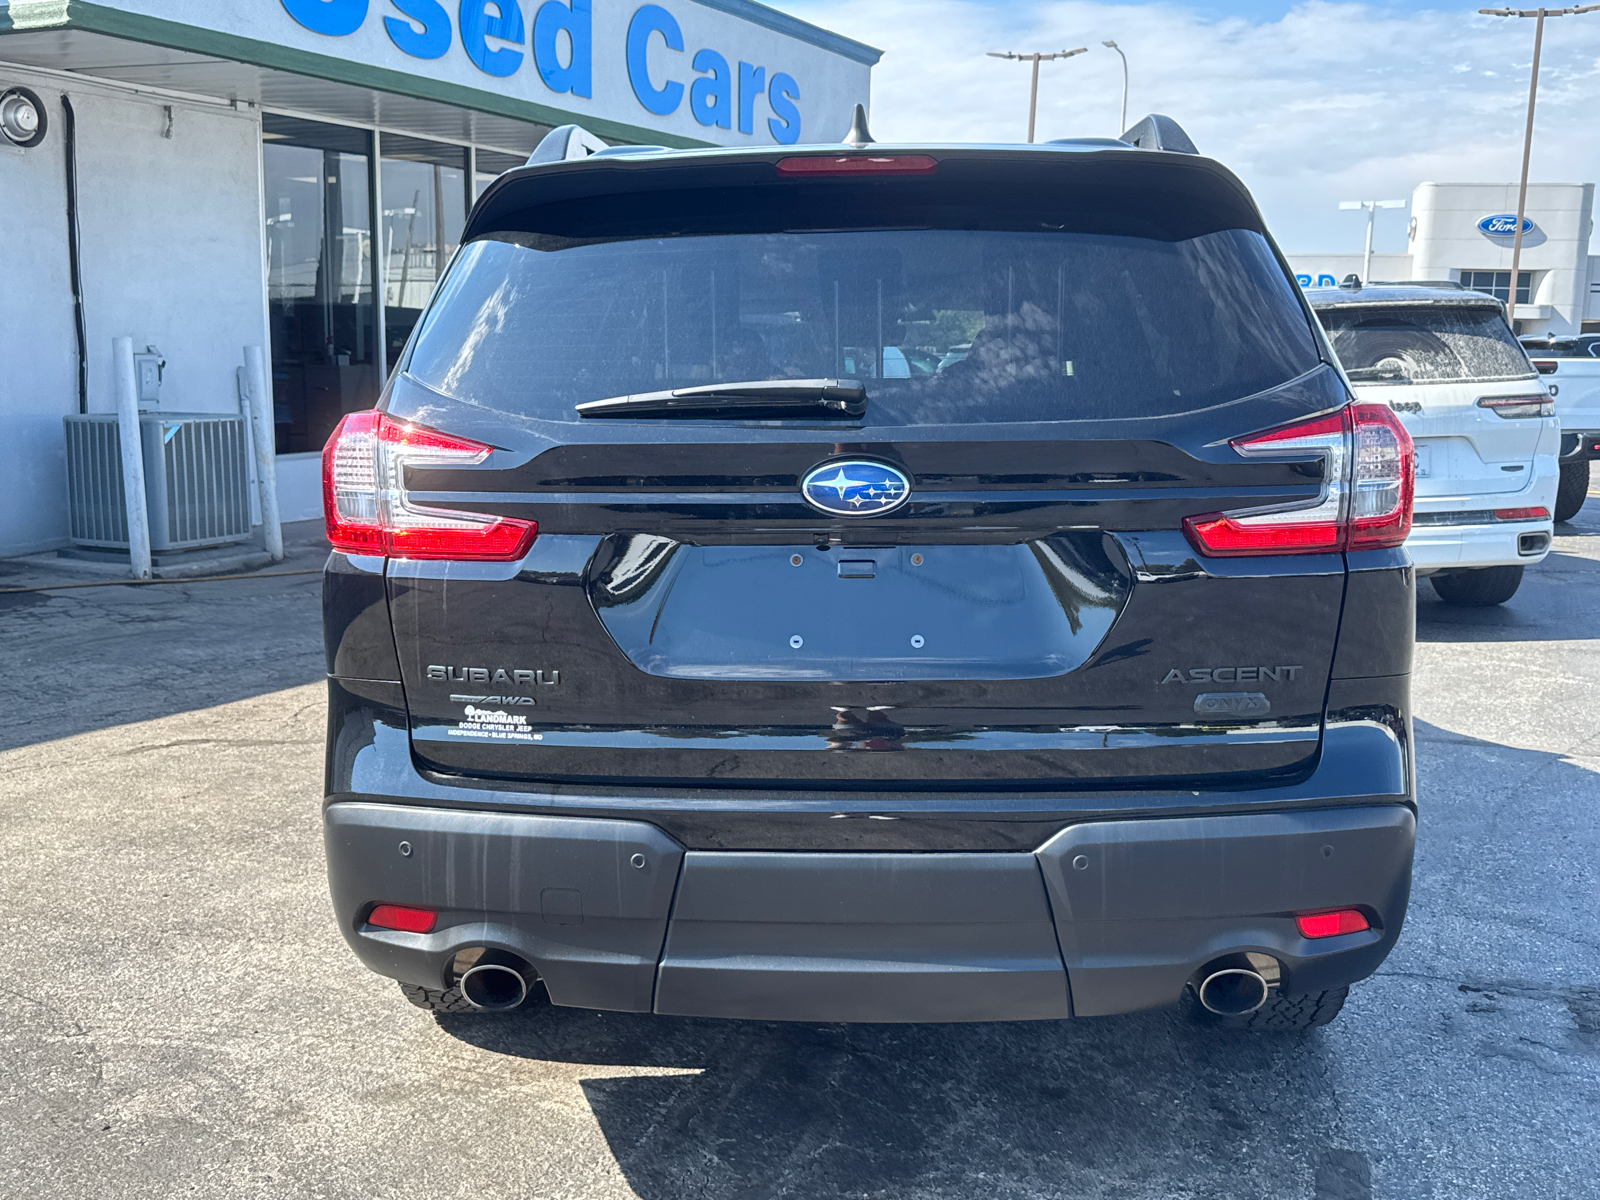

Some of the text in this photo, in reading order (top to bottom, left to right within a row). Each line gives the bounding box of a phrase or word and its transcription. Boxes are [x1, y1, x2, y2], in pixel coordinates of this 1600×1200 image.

[283, 0, 800, 145] sed Cars
[427, 665, 559, 685] SUBARU
[1161, 665, 1303, 684] ASCENT
[481, 696, 536, 705] AWD
[1206, 696, 1259, 708] ONYX
[475, 714, 526, 724] LANDMARK
[459, 722, 480, 730] DODGE
[482, 723, 514, 731] CHRYSLER
